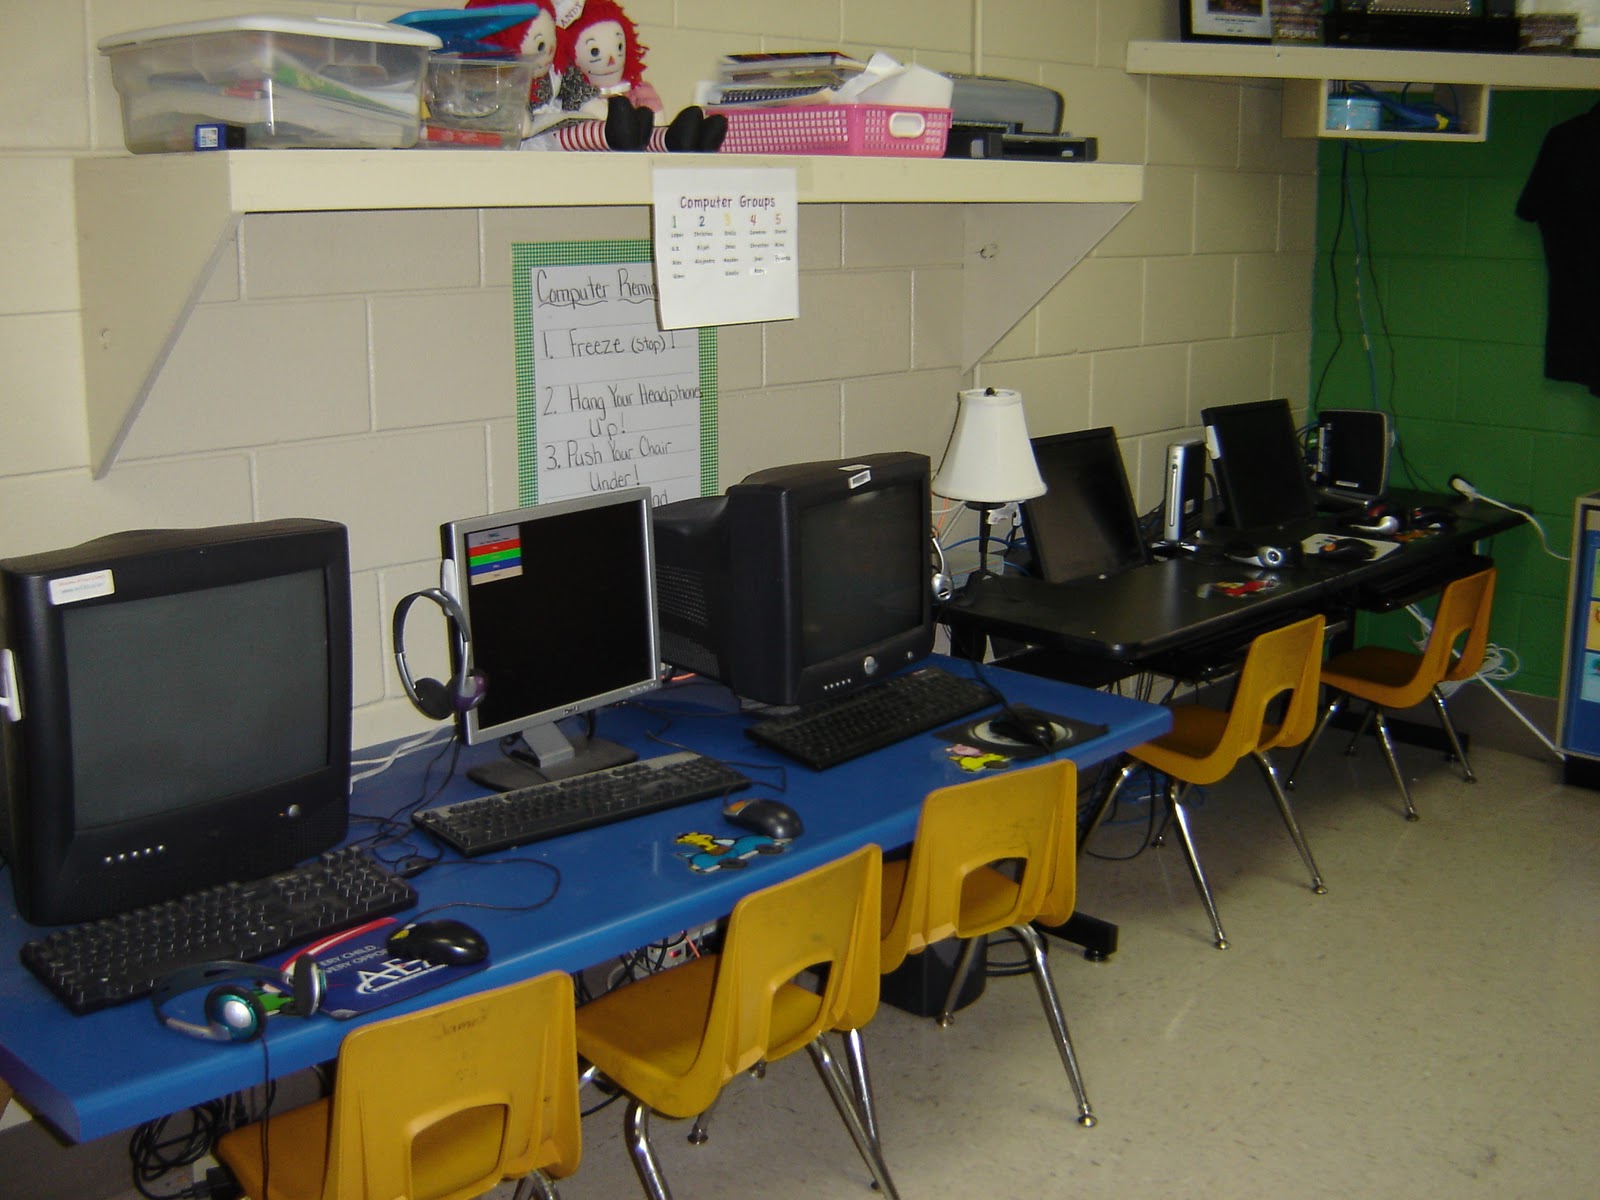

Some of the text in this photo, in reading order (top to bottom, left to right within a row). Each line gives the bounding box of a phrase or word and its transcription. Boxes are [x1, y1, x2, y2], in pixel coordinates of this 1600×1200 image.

[680, 195, 776, 211] Computer Groups
[672, 215, 677, 228] 1
[699, 215, 706, 227] 2
[750, 214, 757, 226] 4
[775, 214, 782, 225] 5
[536, 267, 658, 309] Computer Remin
[569, 328, 625, 358] Freeze
[543, 386, 557, 416] 2.
[569, 386, 607, 420] Hang
[607, 384, 633, 408] Your
[545, 435, 672, 470] 3. Push Your Chair
